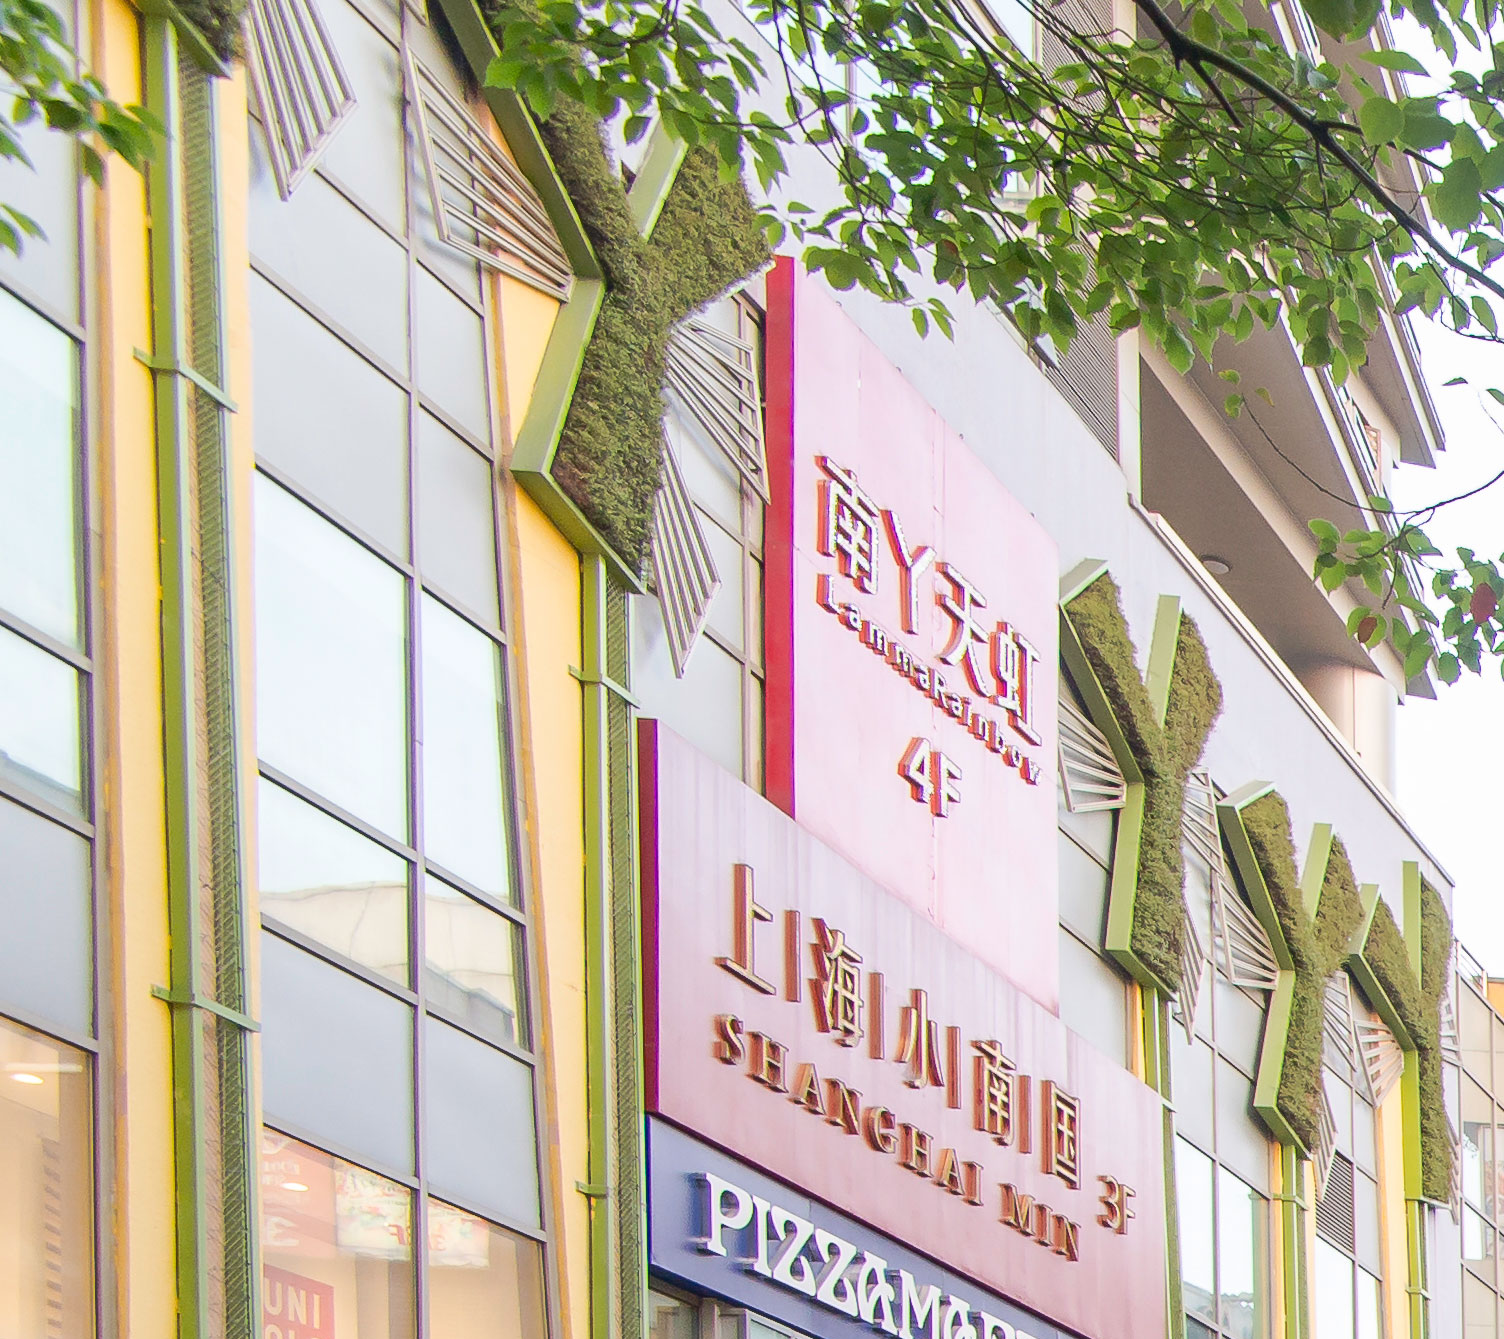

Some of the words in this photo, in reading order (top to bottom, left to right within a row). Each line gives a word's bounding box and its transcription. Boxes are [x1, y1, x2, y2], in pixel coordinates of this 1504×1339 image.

[814, 454, 1042, 747] 南丫天虹
[897, 736, 962, 818] 4F
[713, 1013, 984, 1207] SHANGHAI
[998, 1183, 1081, 1262] MIN
[1097, 1174, 1137, 1235] 3F
[264, 1276, 321, 1330] UNI
